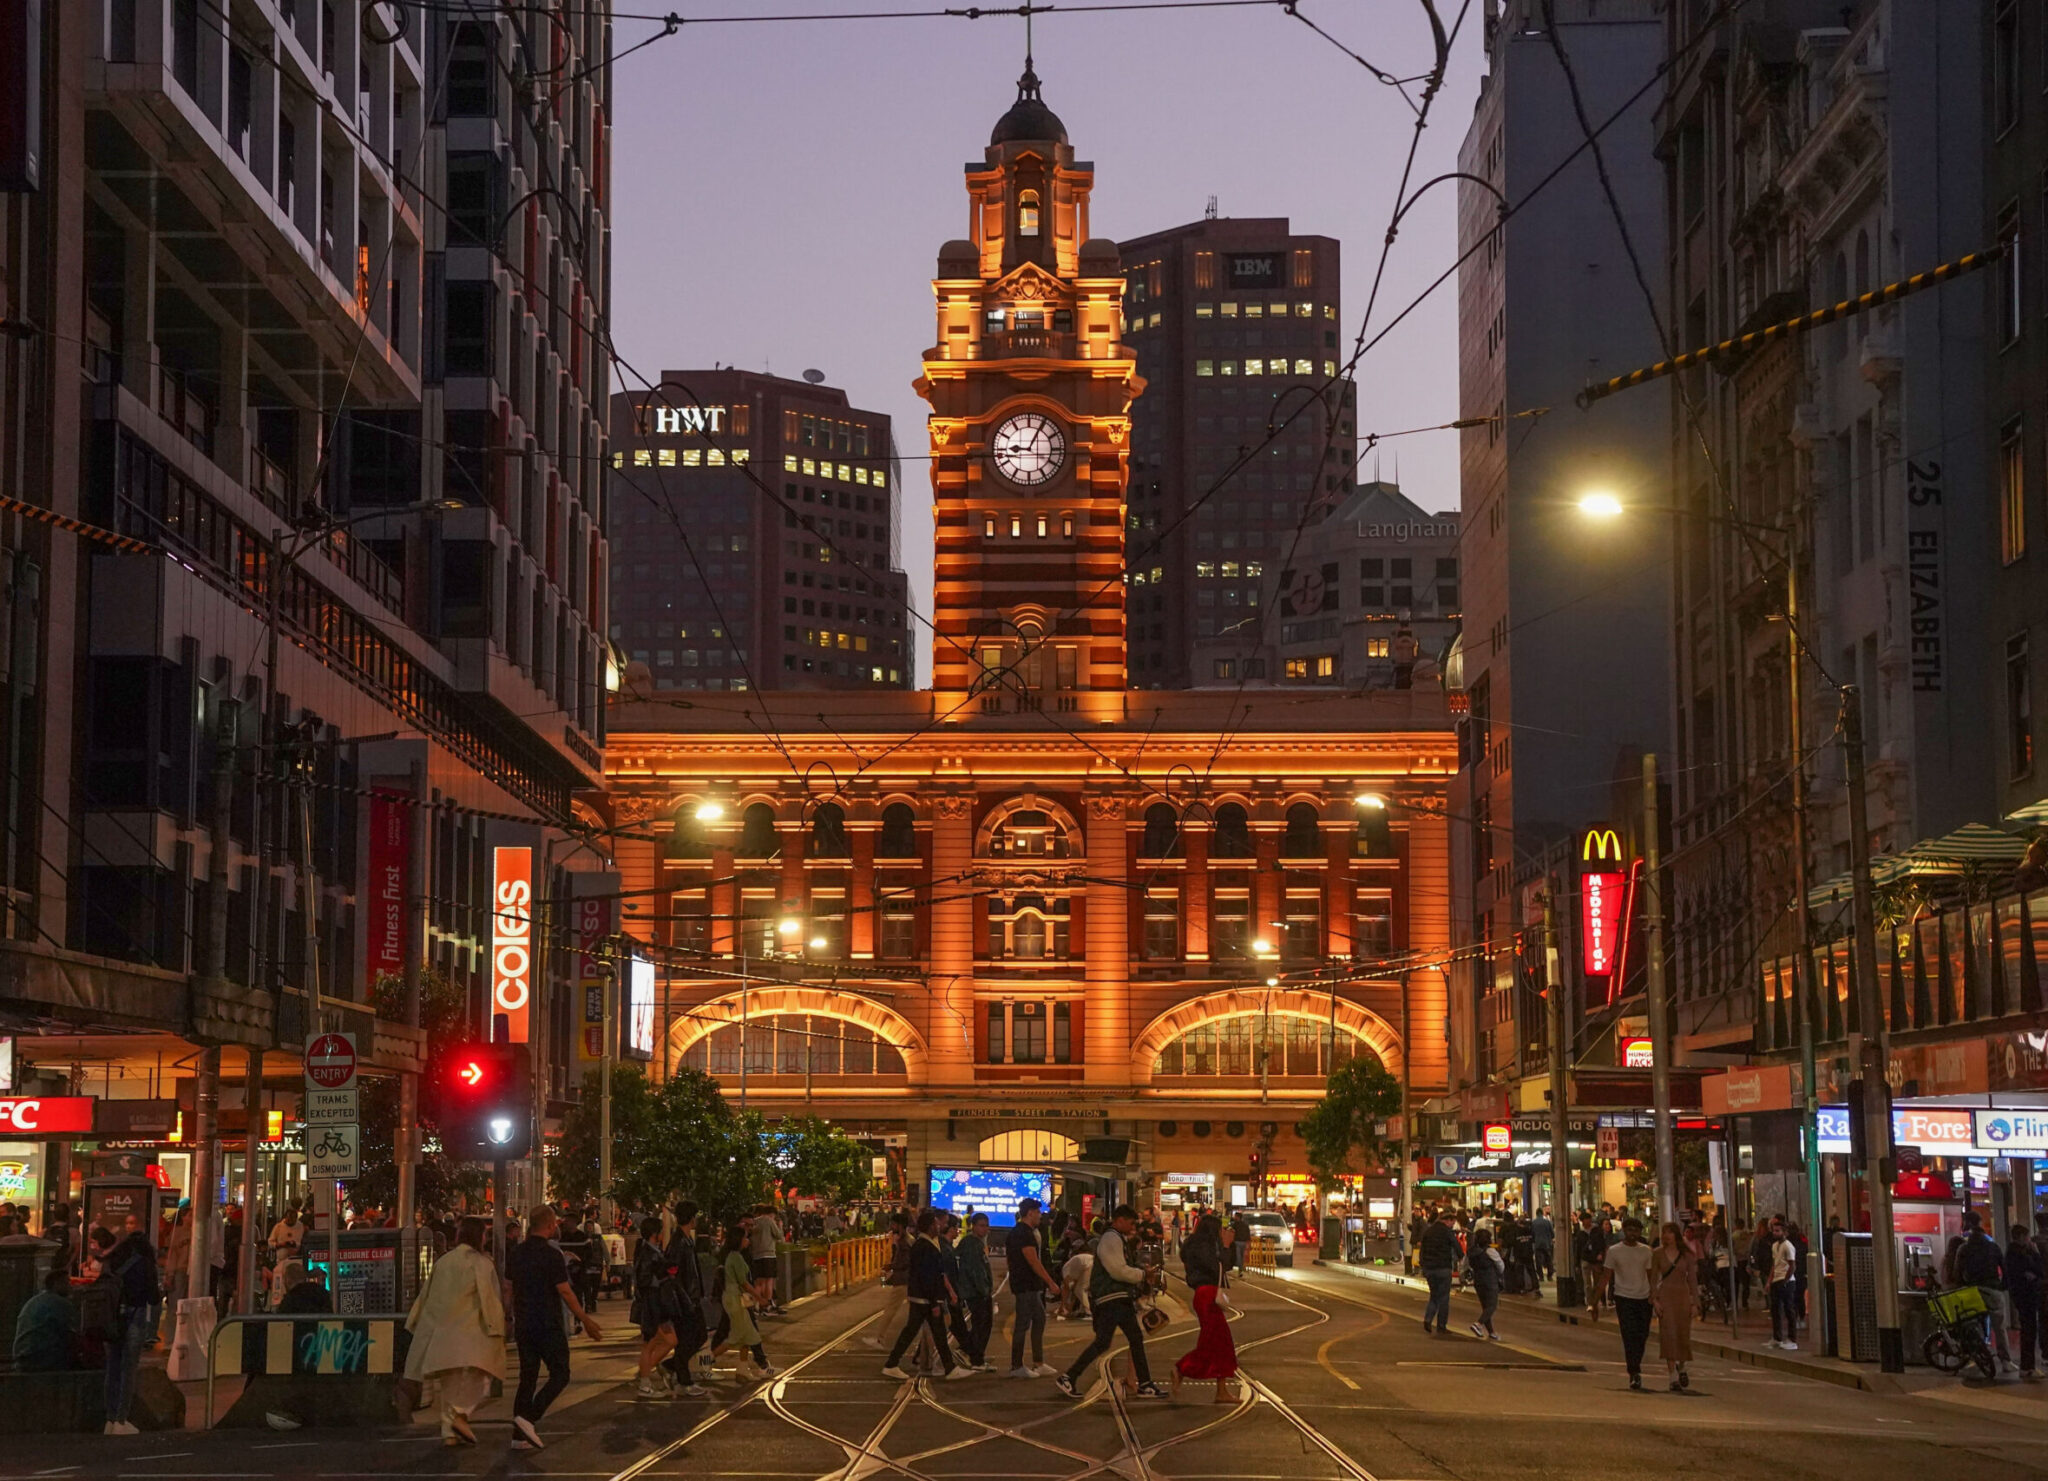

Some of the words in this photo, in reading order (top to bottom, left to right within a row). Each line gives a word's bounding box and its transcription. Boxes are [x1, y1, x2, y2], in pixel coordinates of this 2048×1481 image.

[1234, 259, 1272, 275] IBM
[656, 407, 727, 433] HWT
[1907, 460, 1942, 507] 25
[1357, 518, 1458, 542] Langham
[1908, 530, 1942, 693] ELIZABETH
[1588, 874, 1608, 972] McDonald's
[496, 879, 531, 1010] coles
[323, 1042, 339, 1053] NO
[313, 1068, 349, 1081] ENTRY
[316, 1094, 349, 1104] TRAMS
[309, 1108, 355, 1118] EXCEPTED
[956, 1108, 1001, 1117] FLINDERS
[1014, 1108, 1047, 1117] STREET
[1060, 1108, 1100, 1117] STATION
[312, 1164, 352, 1174] DISMOUNT
[965, 1185, 988, 1195] From
[310, 1251, 329, 1260] KEEP
[339, 1250, 370, 1260] LBOURNE
[371, 1249, 393, 1258] CLEAN
